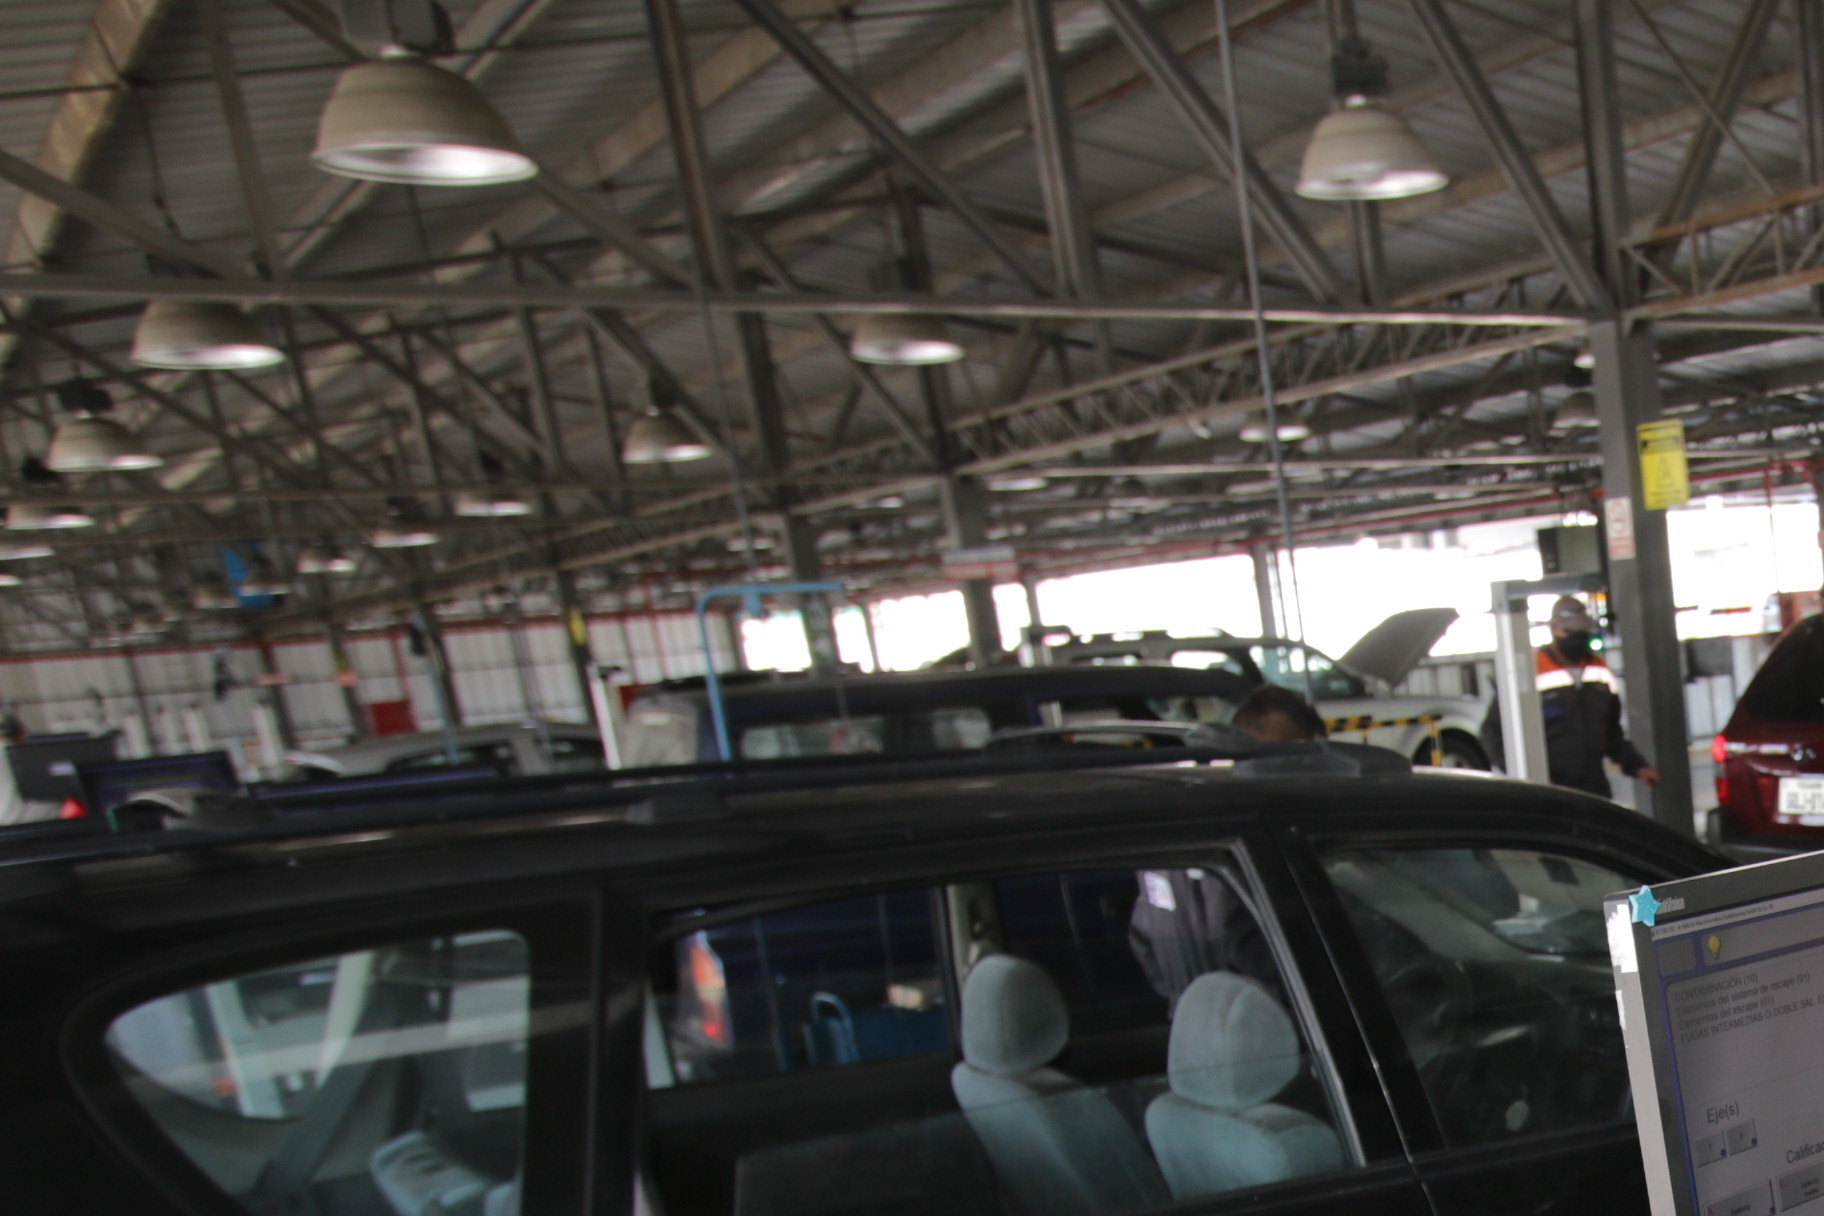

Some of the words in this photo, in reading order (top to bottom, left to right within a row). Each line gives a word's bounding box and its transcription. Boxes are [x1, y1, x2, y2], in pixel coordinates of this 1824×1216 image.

[1718, 994, 1730, 1005] del
[1759, 984, 1769, 994] de
[1770, 977, 1795, 990] escape
[1719, 1007, 1731, 1018] del
[1733, 1001, 1759, 1015] escape
[1773, 1002, 1798, 1017] DOBLE
[1706, 1100, 1740, 1125] Eje(s)
